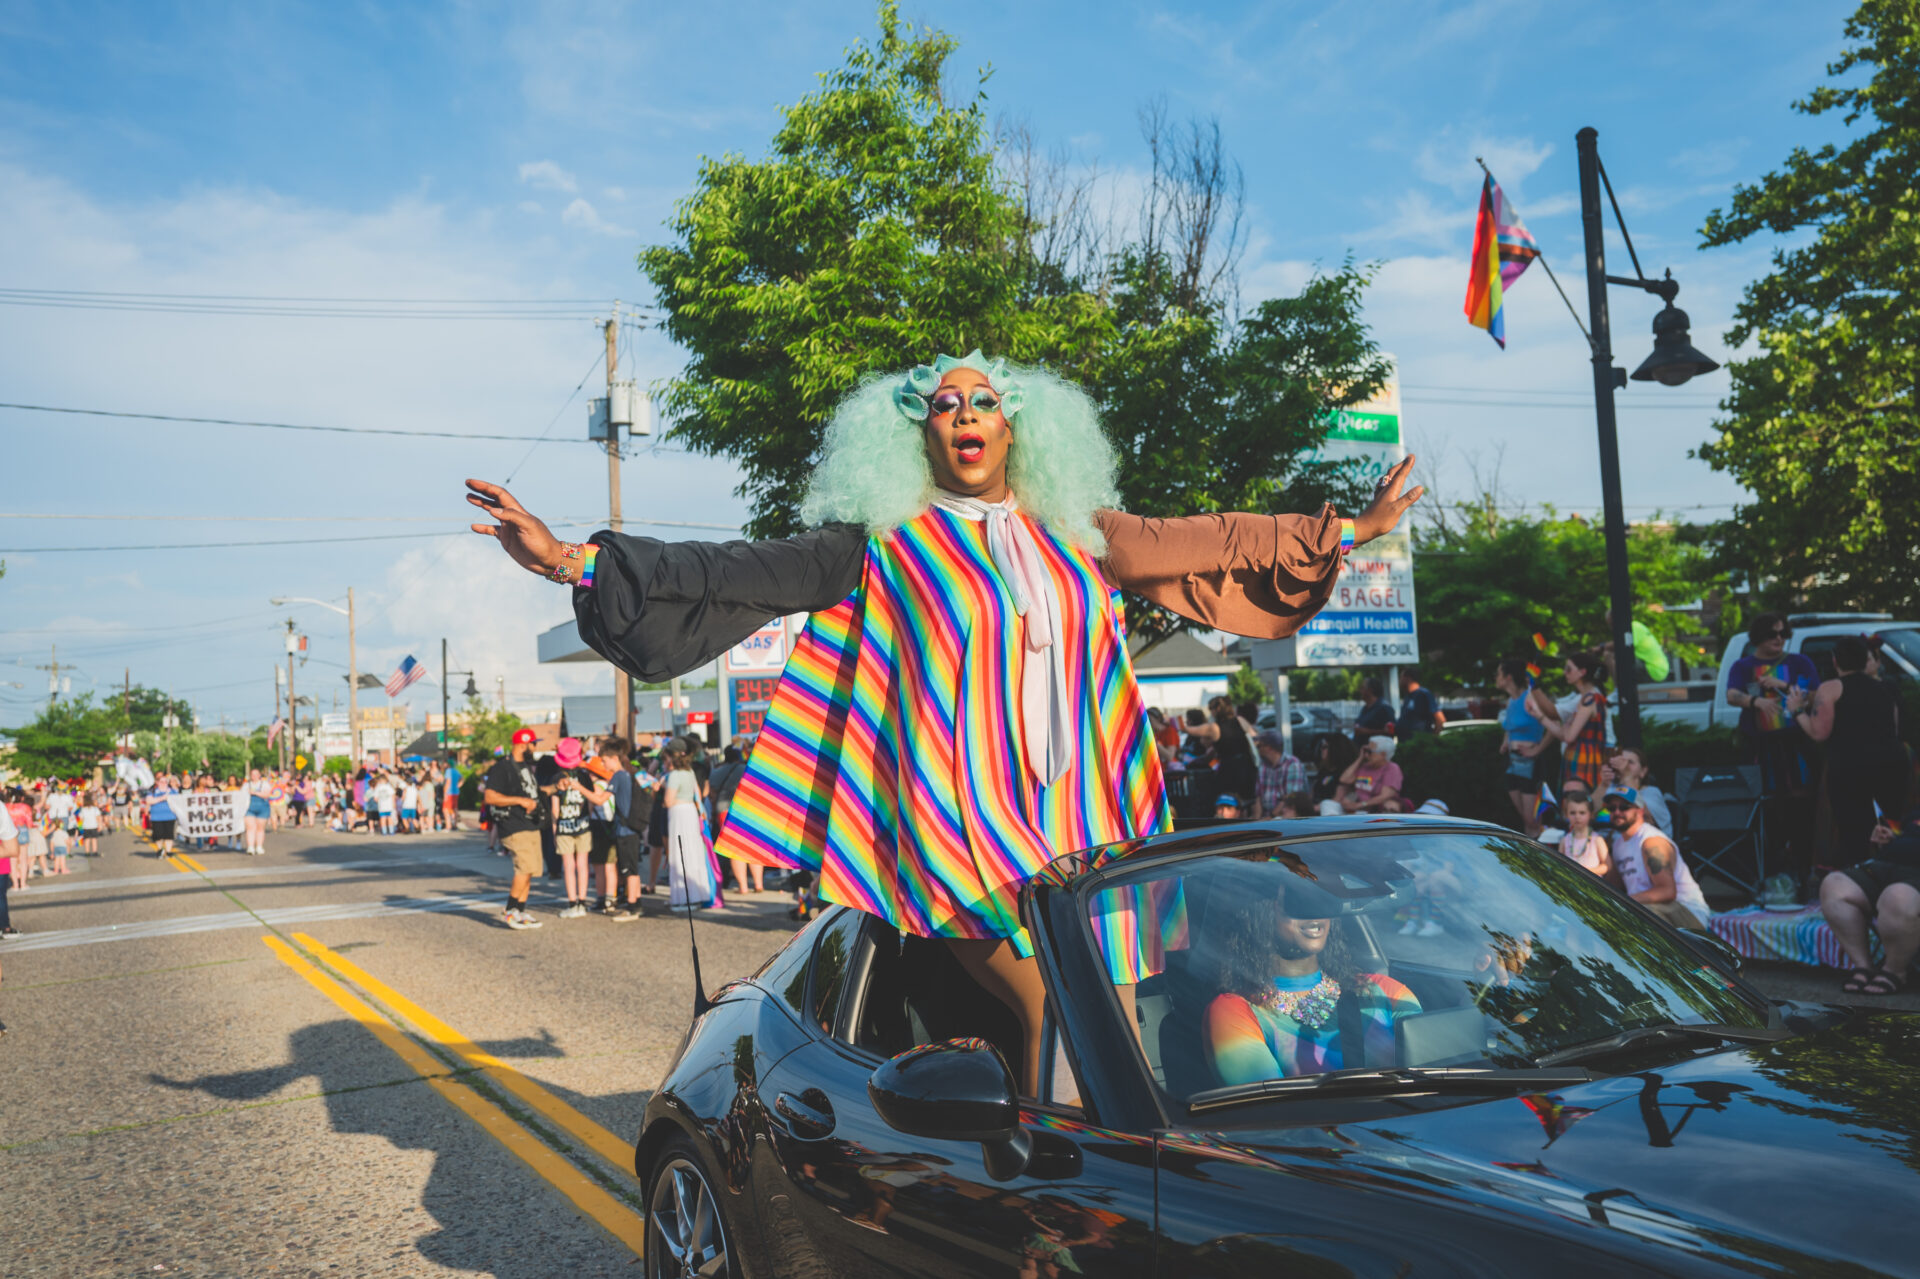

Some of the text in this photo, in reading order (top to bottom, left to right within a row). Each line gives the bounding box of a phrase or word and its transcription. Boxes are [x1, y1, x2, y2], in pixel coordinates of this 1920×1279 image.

[1340, 587, 1405, 607] BAGEL
[1305, 617, 1409, 632] Tranquil Health
[741, 636, 774, 650] GAS
[1348, 644, 1378, 657] POKE
[187, 794, 233, 807] FREE
[188, 808, 233, 823] MOM
[189, 822, 233, 834] HUGS
